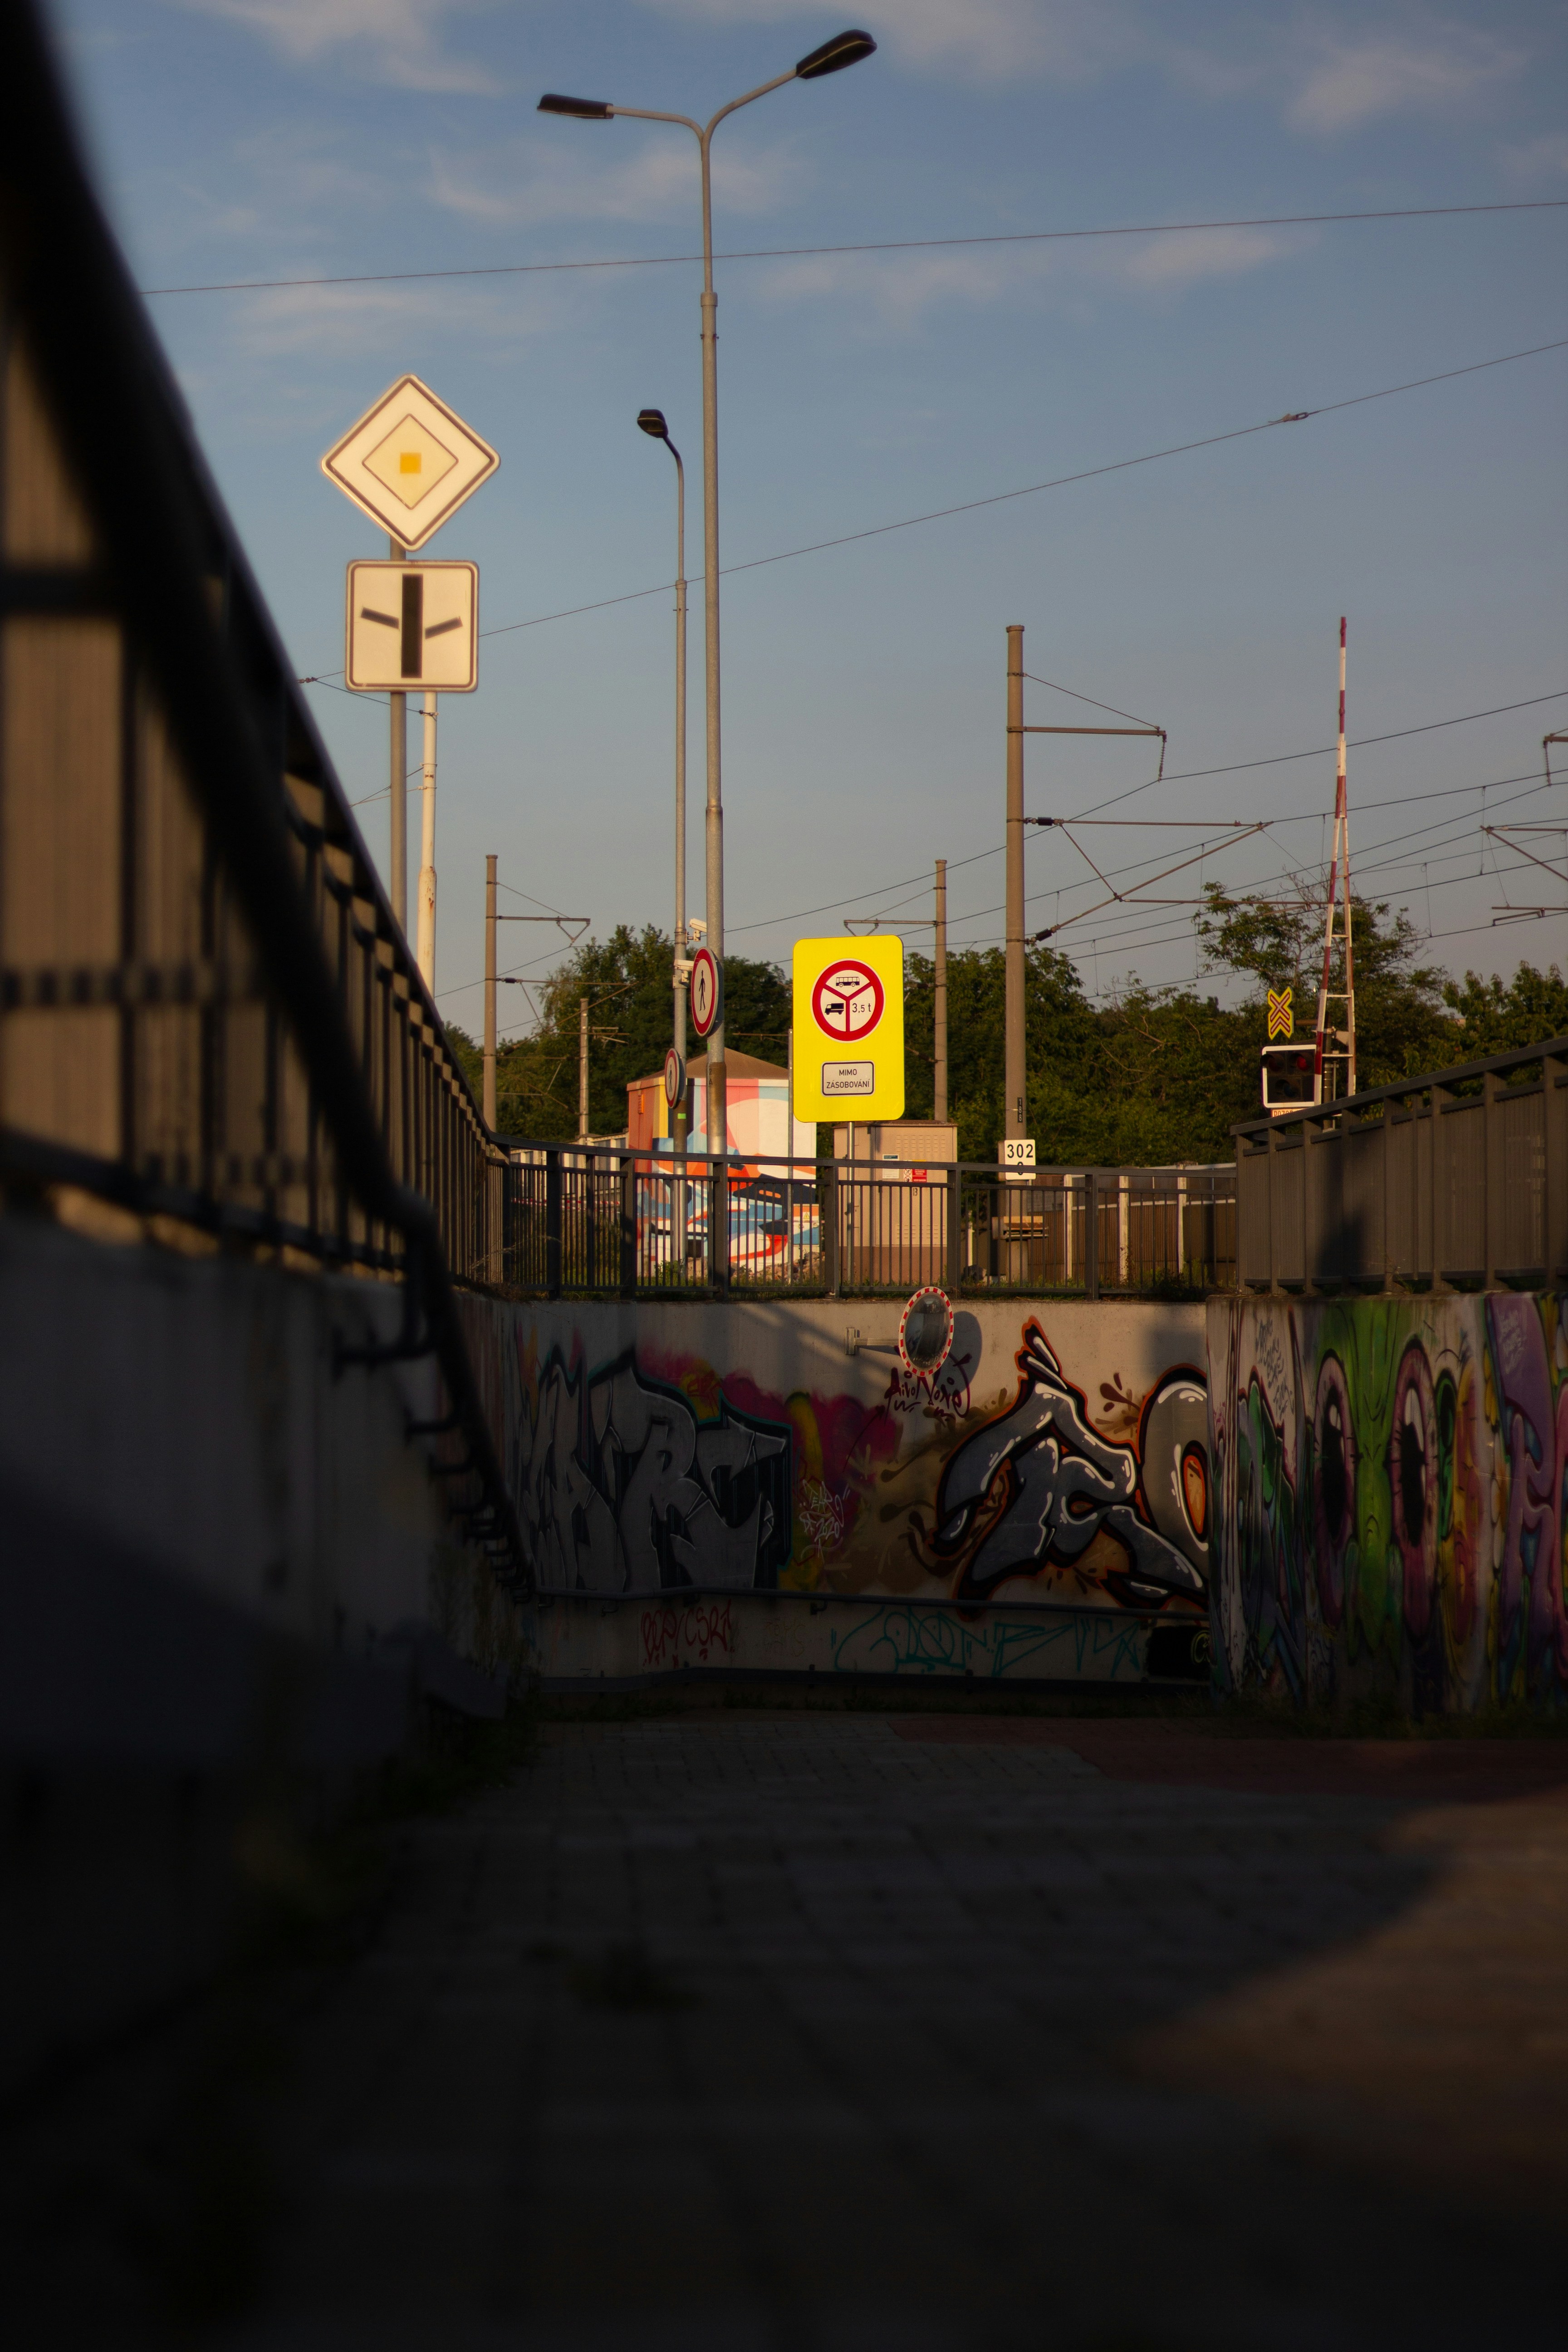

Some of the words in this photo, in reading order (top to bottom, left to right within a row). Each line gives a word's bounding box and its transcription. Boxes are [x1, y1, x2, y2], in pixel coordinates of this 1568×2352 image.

[852, 1002, 865, 1013] 3,5
[867, 1003, 872, 1012] t
[826, 1078, 871, 1089] ZÁSOBOVÁNÍ
[1007, 1143, 1034, 1158] 302
